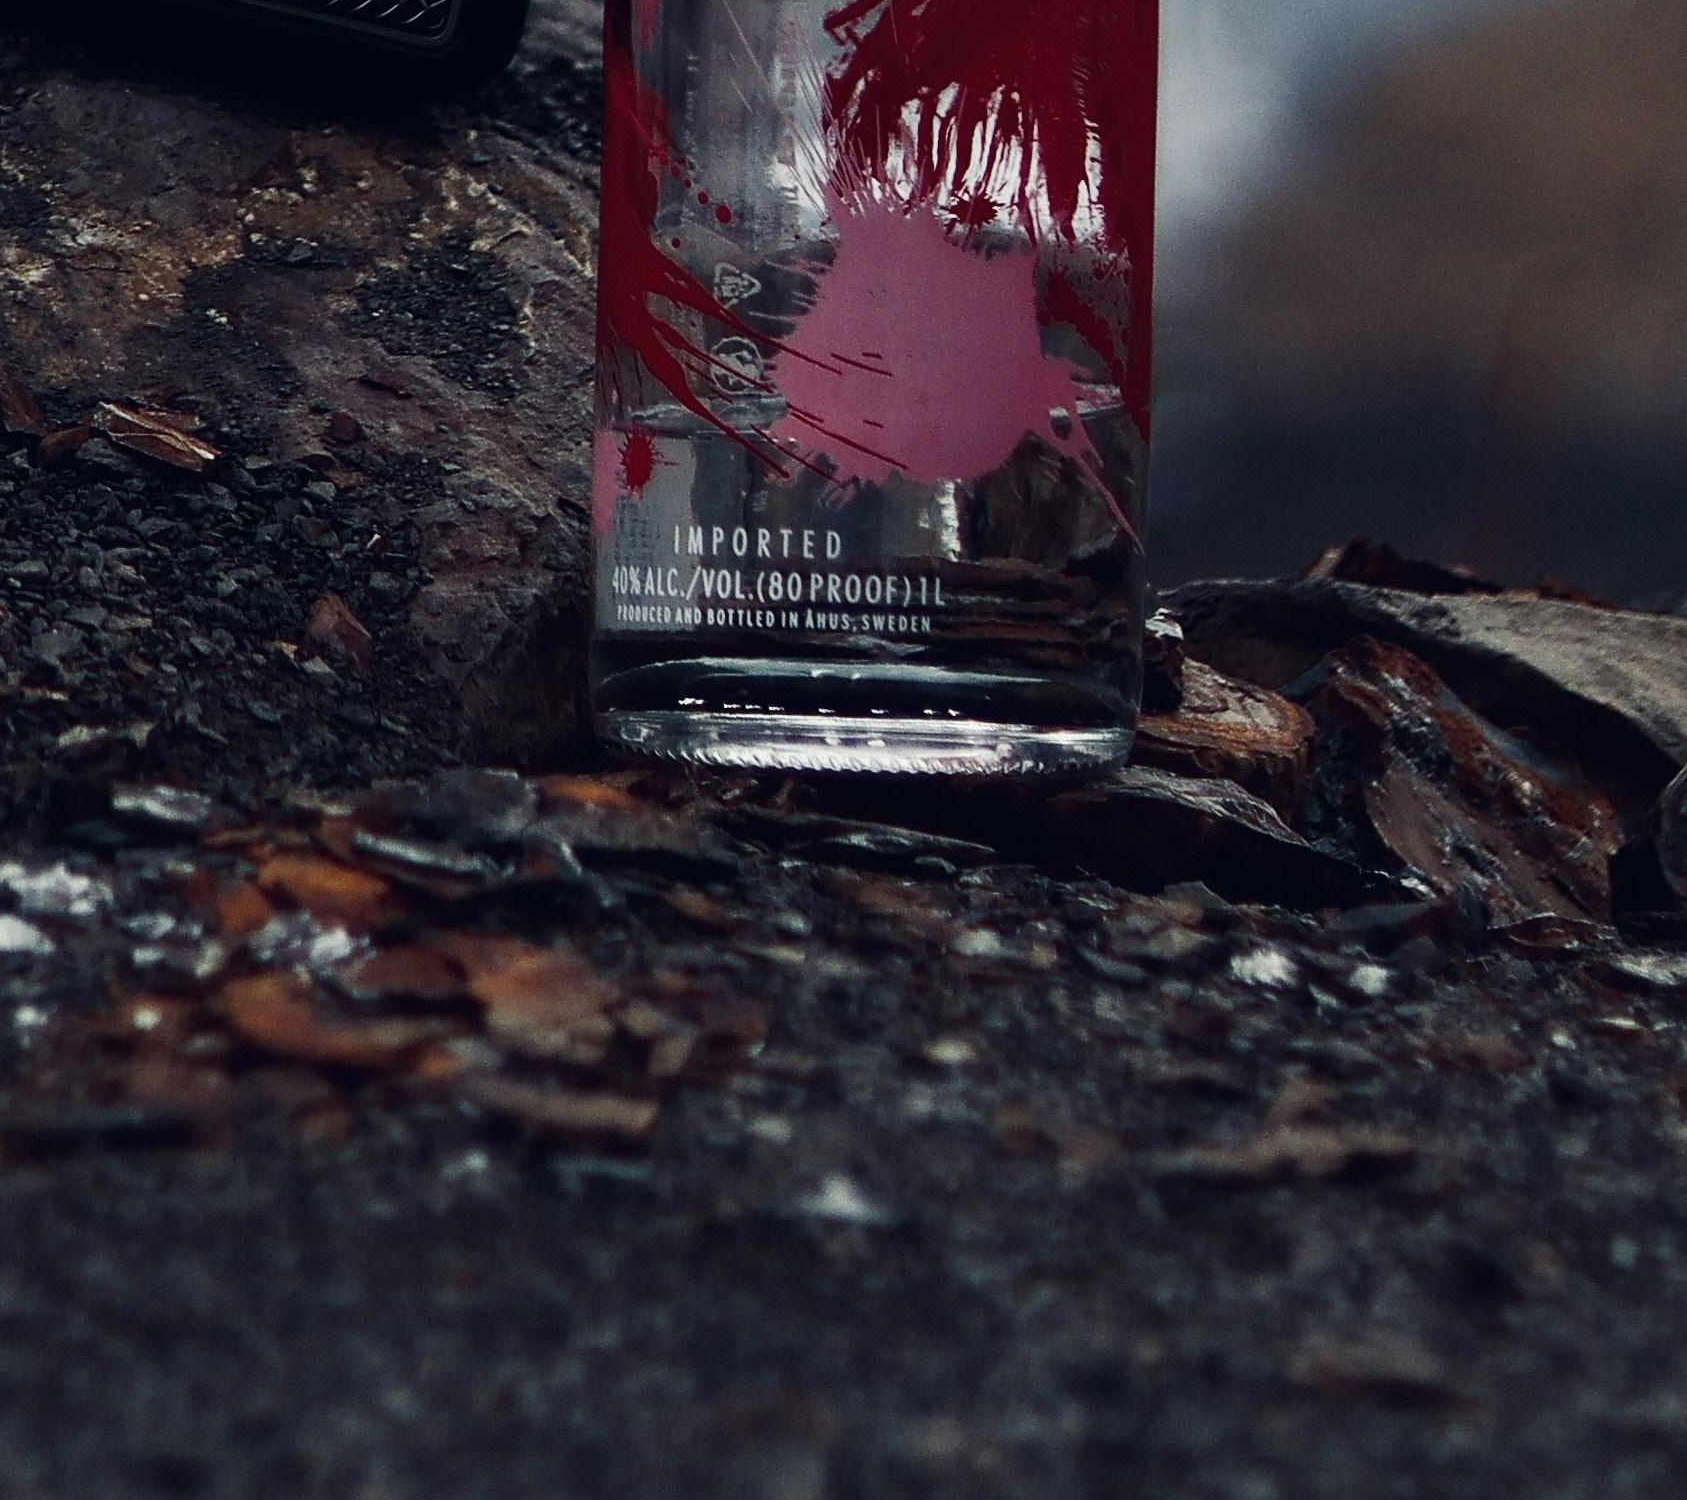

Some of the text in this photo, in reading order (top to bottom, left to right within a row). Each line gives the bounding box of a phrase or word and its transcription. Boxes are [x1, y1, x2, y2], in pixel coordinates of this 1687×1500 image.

[673, 524, 841, 560] IMPORTED
[612, 565, 641, 595] 40%
[810, 572, 911, 608] PROOF)
[617, 604, 671, 623] PRODUCED
[674, 605, 702, 625] AND
[706, 608, 775, 628] BOTTLED
[781, 610, 799, 629] IN
[861, 614, 931, 633] SWEDEN
